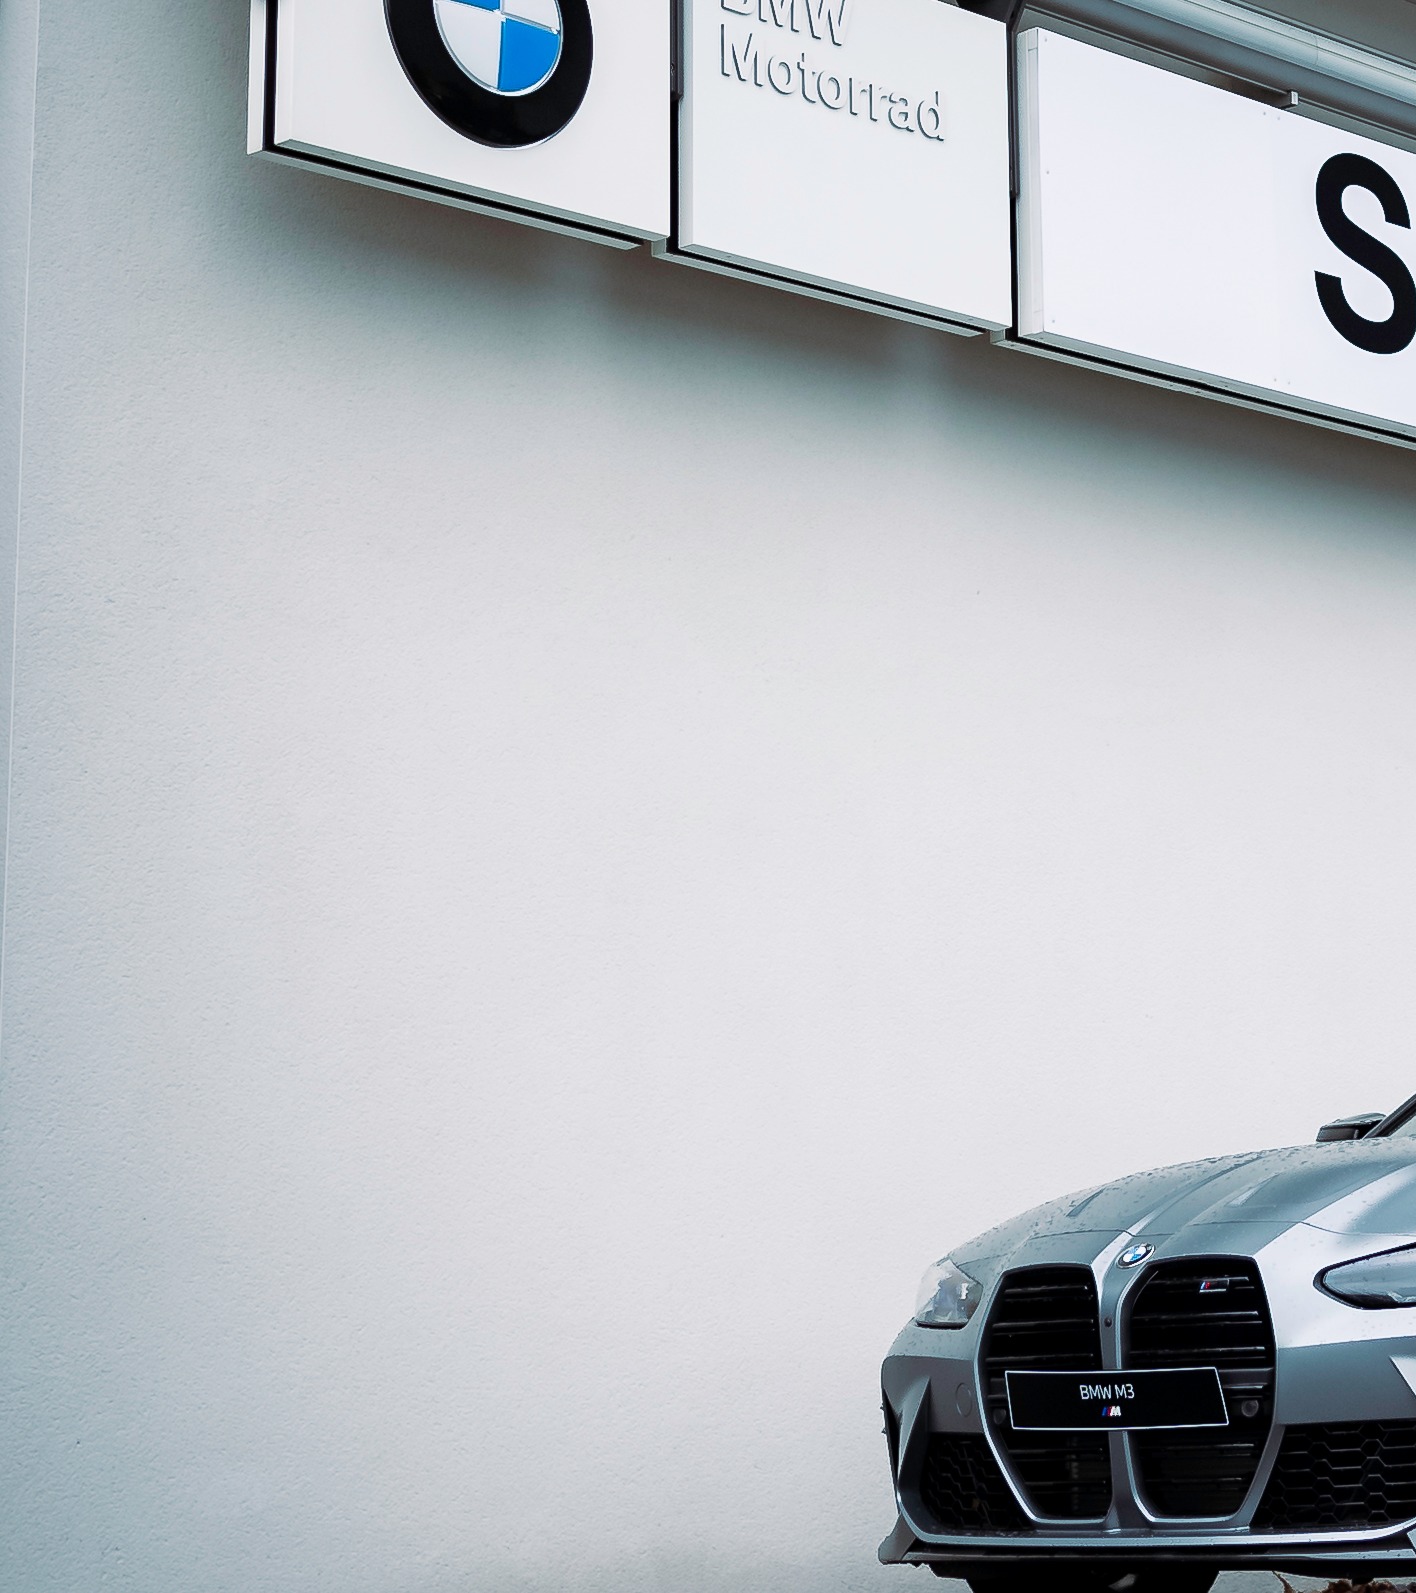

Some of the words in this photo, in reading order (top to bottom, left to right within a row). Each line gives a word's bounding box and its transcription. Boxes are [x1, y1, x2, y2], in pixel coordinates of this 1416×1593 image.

[721, 0, 846, 46] MW
[721, 23, 945, 141] Motorrad
[1079, 1384, 1112, 1400] BMW
[1114, 1383, 1135, 1399] M3
